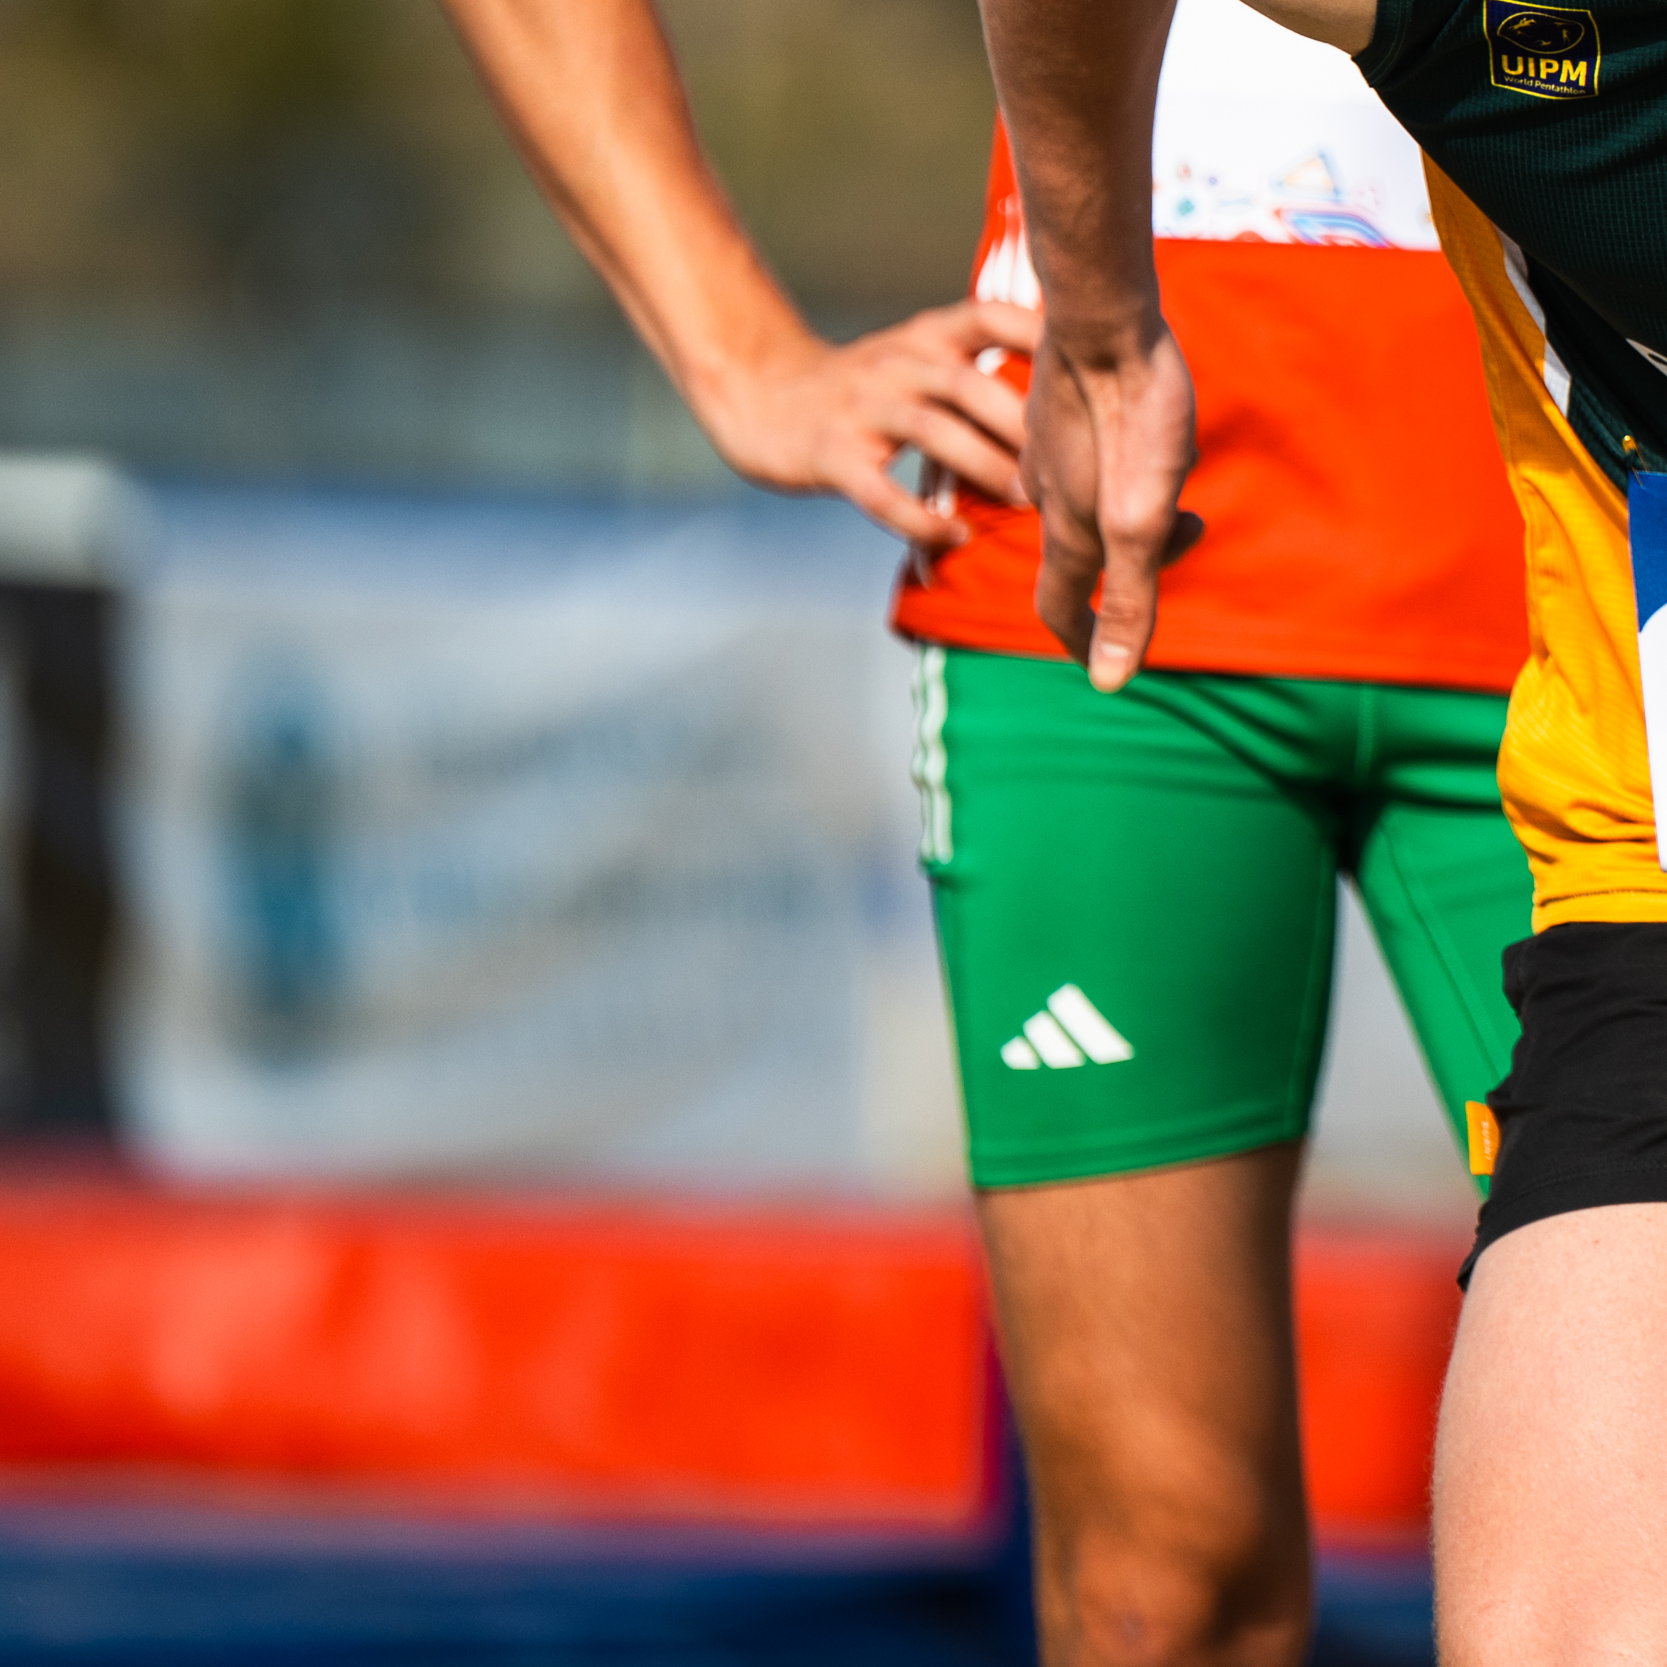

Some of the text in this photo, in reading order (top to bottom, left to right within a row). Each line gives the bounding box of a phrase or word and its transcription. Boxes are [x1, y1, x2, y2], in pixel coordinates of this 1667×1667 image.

[1501, 54, 1588, 87] UIPM
[1504, 75, 1587, 95] World Pentathlon
